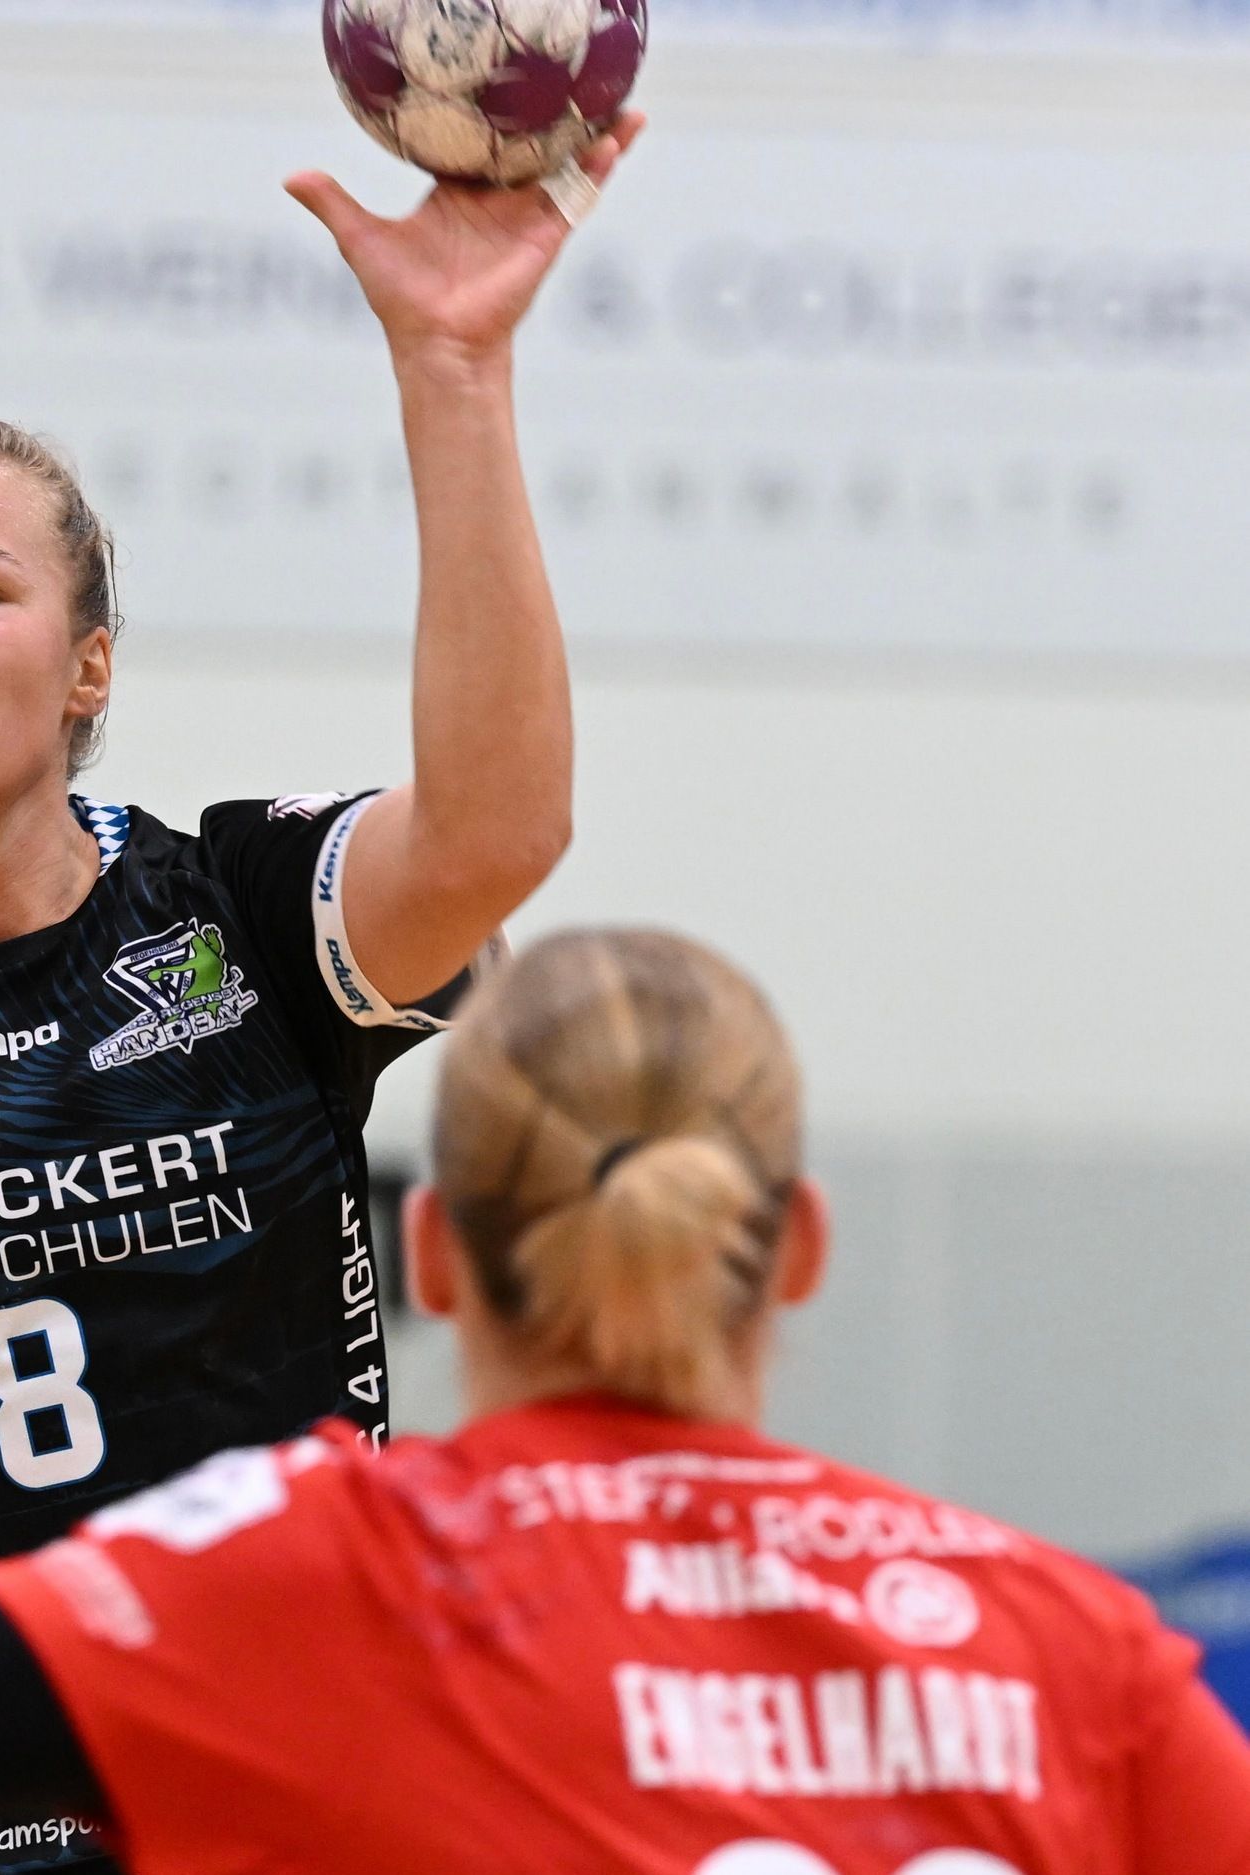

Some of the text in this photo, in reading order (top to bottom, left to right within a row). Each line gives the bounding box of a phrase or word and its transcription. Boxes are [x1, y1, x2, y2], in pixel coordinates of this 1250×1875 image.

[326, 938, 374, 1015] Kempa
[348, 1364, 383, 1405] 4
[614, 1662, 1041, 1800] ENGELHARDT
